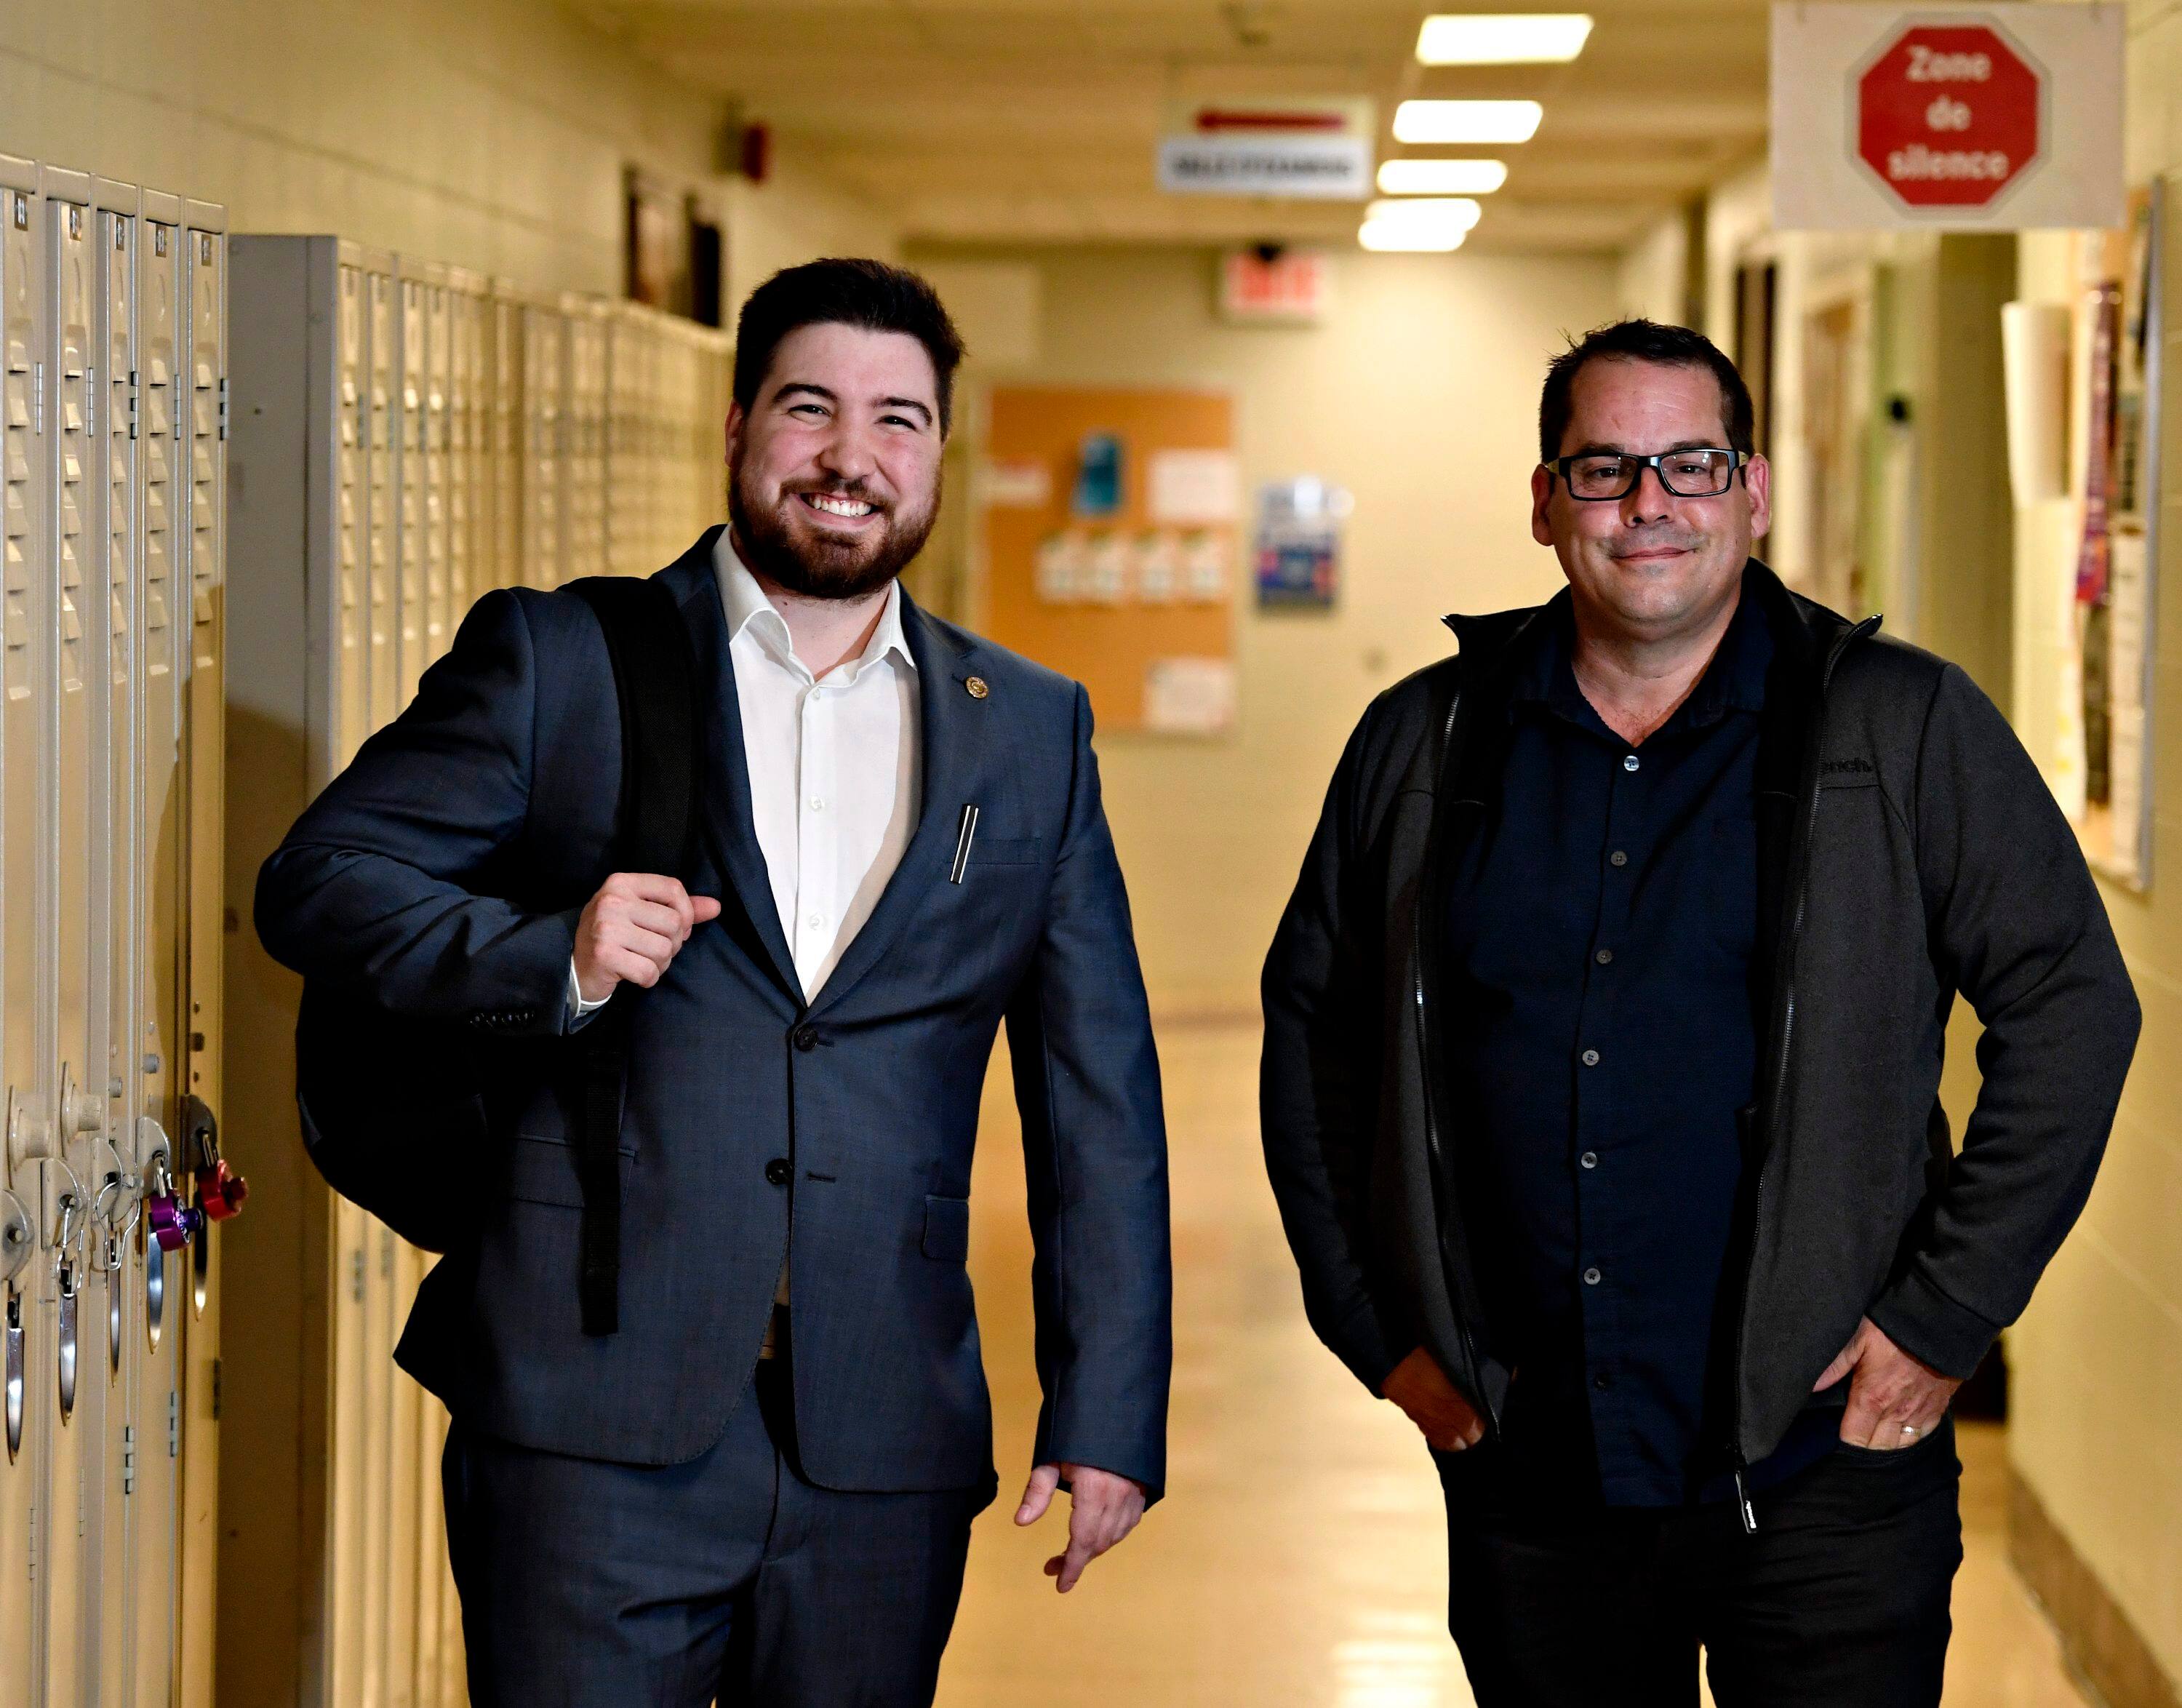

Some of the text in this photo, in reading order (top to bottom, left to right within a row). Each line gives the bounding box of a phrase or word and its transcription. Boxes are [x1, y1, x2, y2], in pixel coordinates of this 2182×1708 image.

[1906, 45, 1991, 81] Zone
[1926, 95, 1970, 130] de
[1888, 145, 2008, 180] silence
